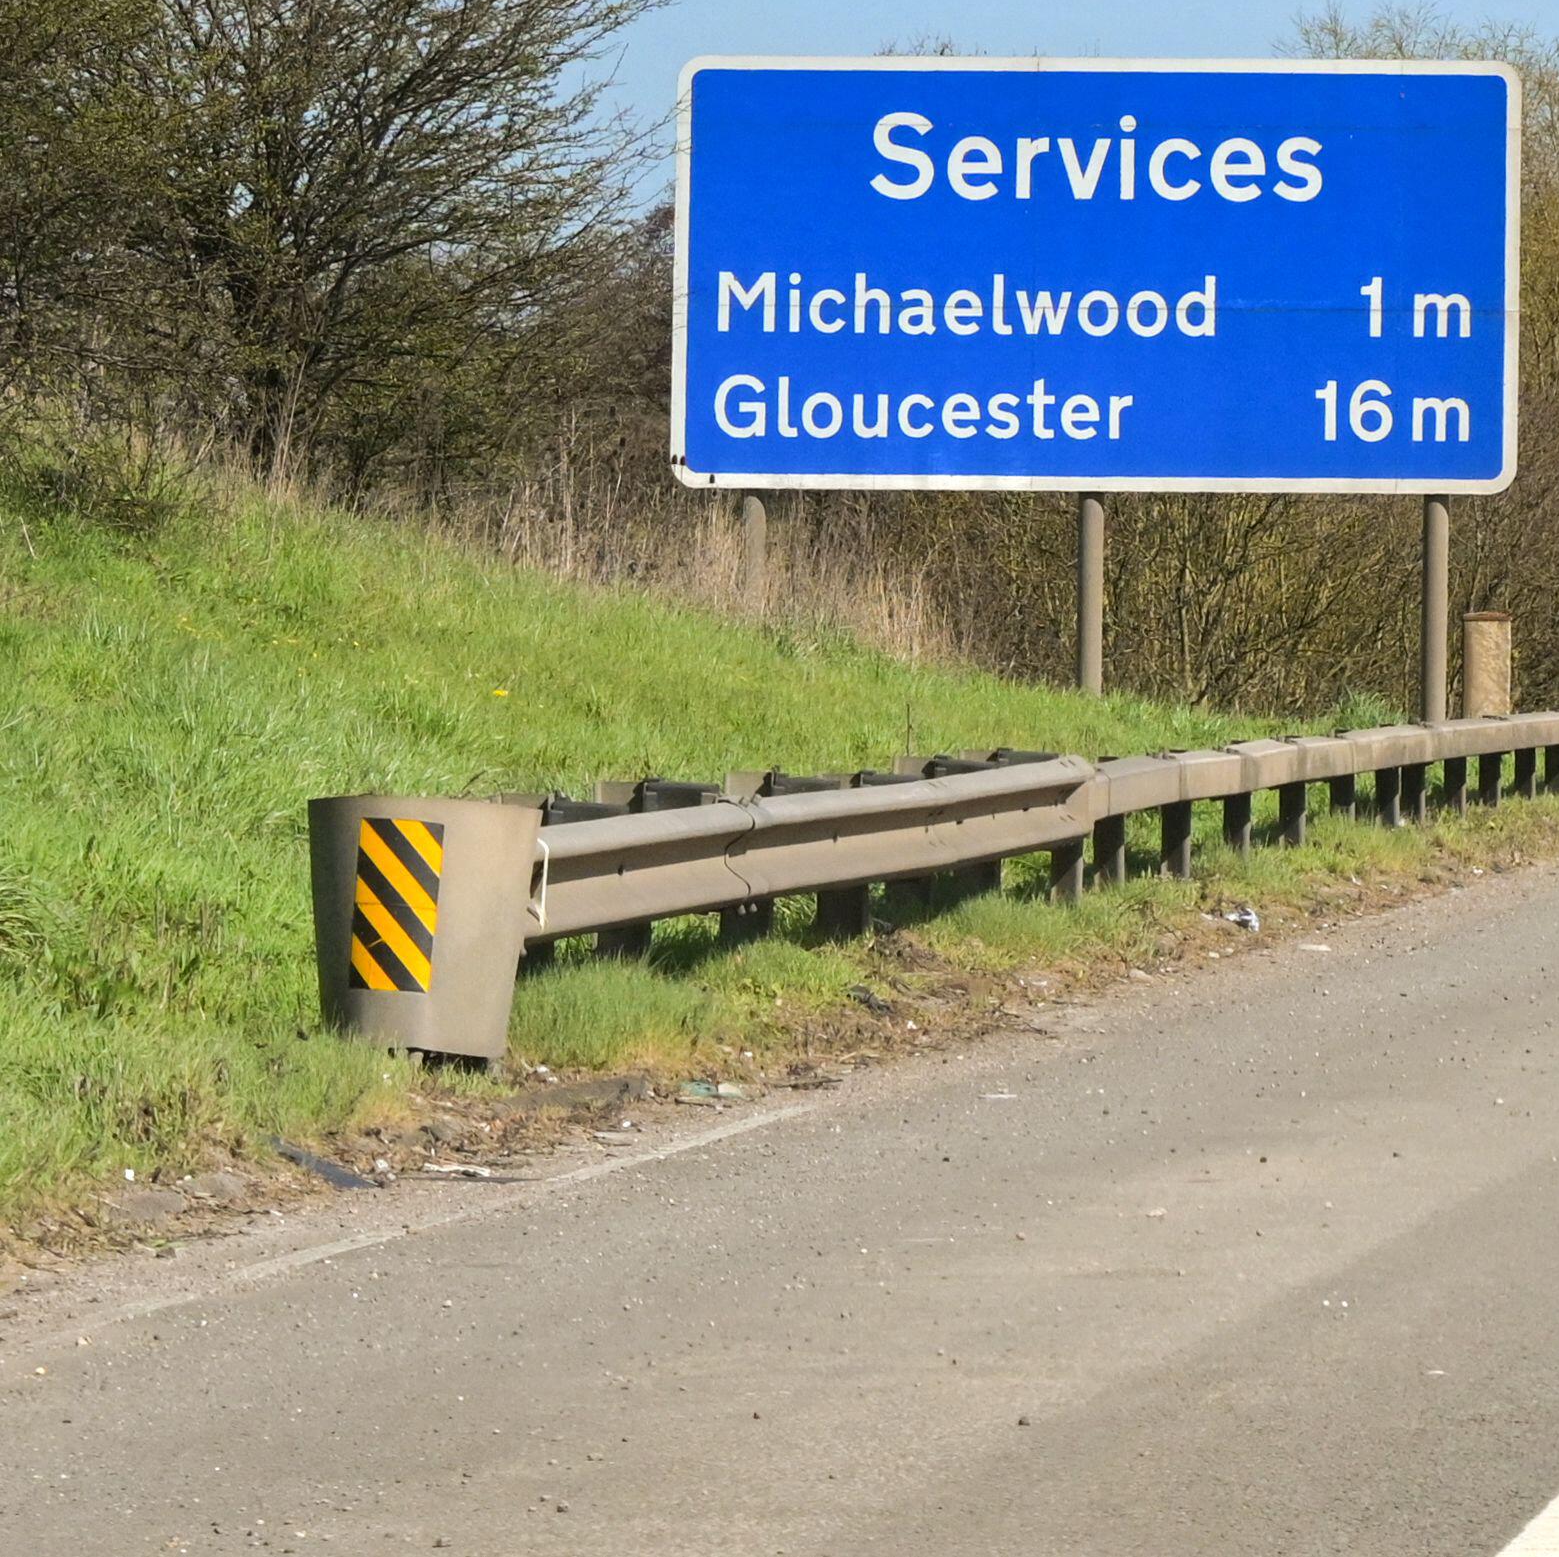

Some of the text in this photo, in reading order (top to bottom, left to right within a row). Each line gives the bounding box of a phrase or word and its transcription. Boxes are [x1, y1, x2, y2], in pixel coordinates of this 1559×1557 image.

[870, 112, 1323, 202] Services
[717, 271, 1471, 338] Michaelwood 1 m
[714, 375, 1134, 440] Gloucester
[1315, 379, 1394, 443] 16
